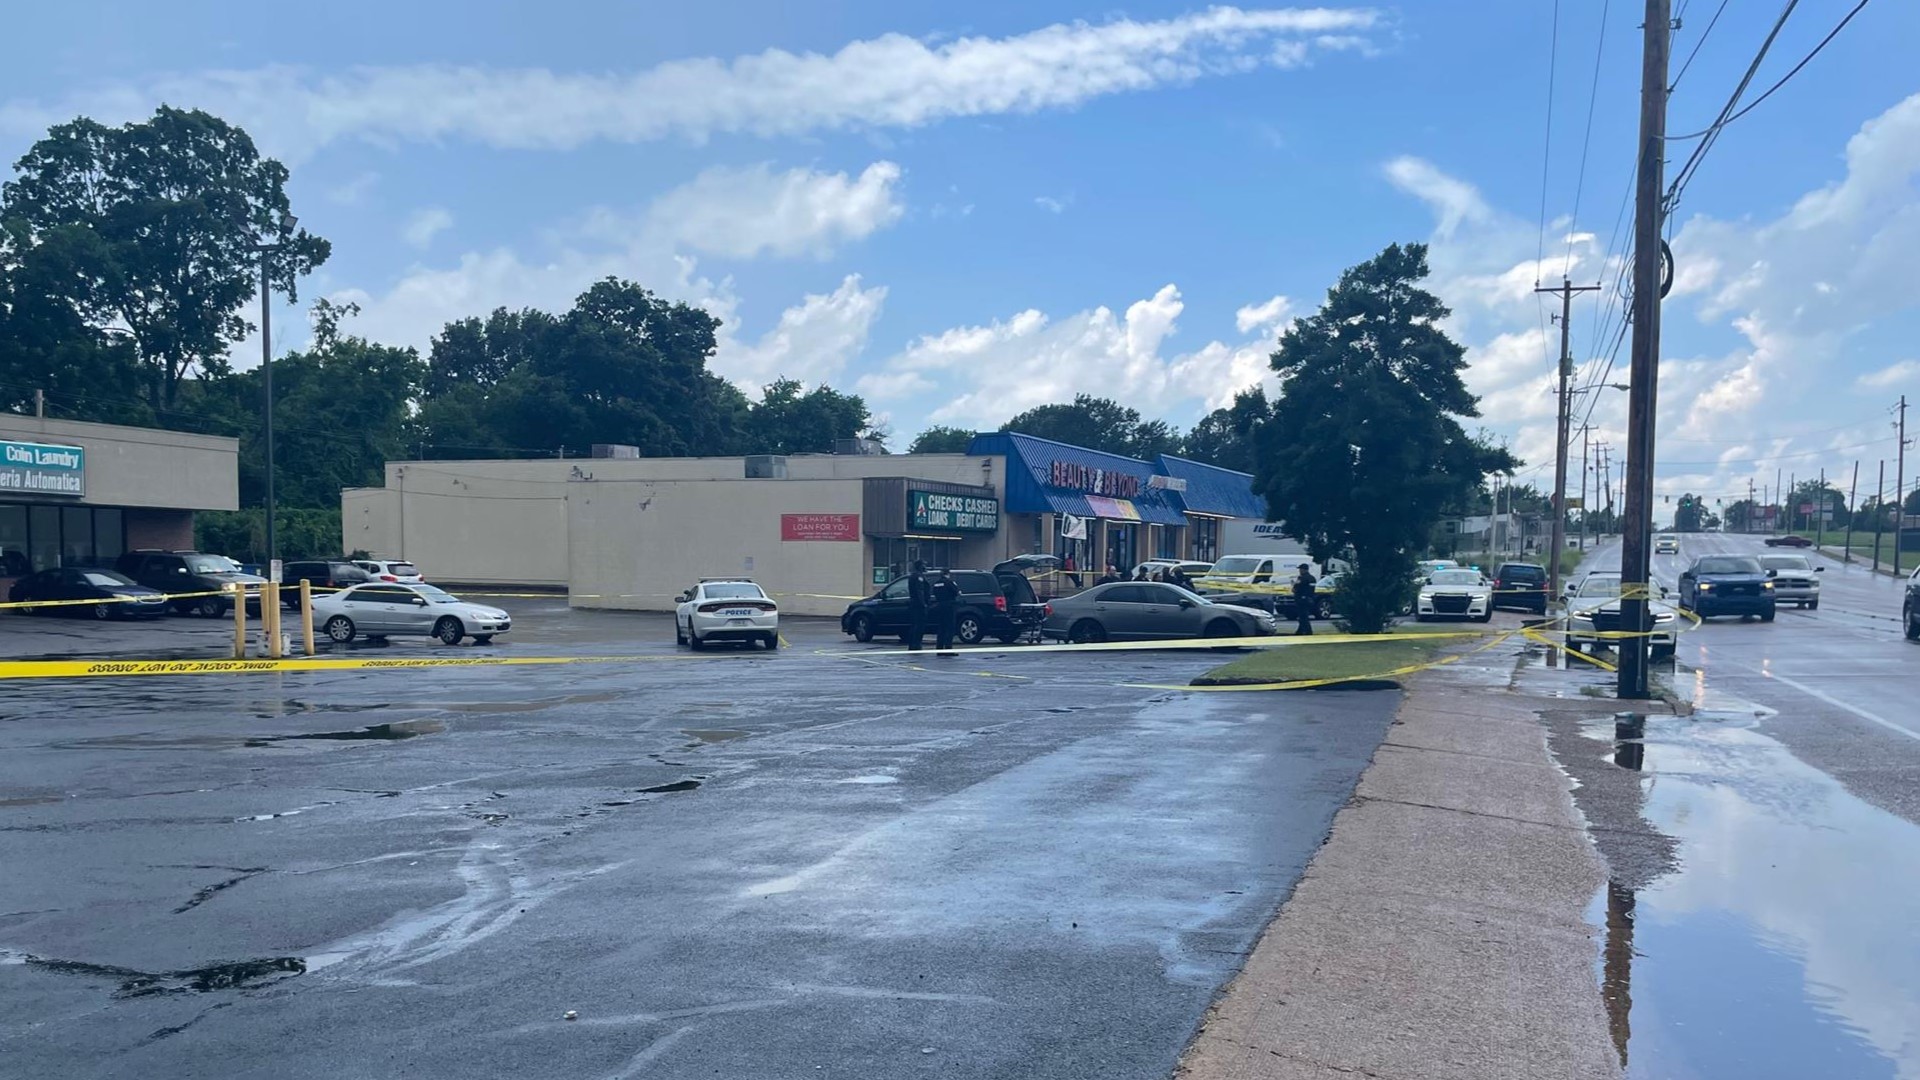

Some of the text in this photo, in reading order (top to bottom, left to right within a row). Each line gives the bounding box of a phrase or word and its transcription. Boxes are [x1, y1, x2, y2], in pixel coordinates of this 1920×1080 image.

[6, 445, 79, 469] Coin Laundry
[0, 469, 80, 491] eria Automatica
[1053, 460, 1096, 492] BEAUTY
[1094, 469, 1104, 494] &
[1104, 471, 1140, 497] BEYOND
[928, 494, 997, 514] CHECKS CASHED
[792, 523, 850, 531] LOAN FOR YOU
[928, 510, 997, 529] LOANS DEBIT CARDS
